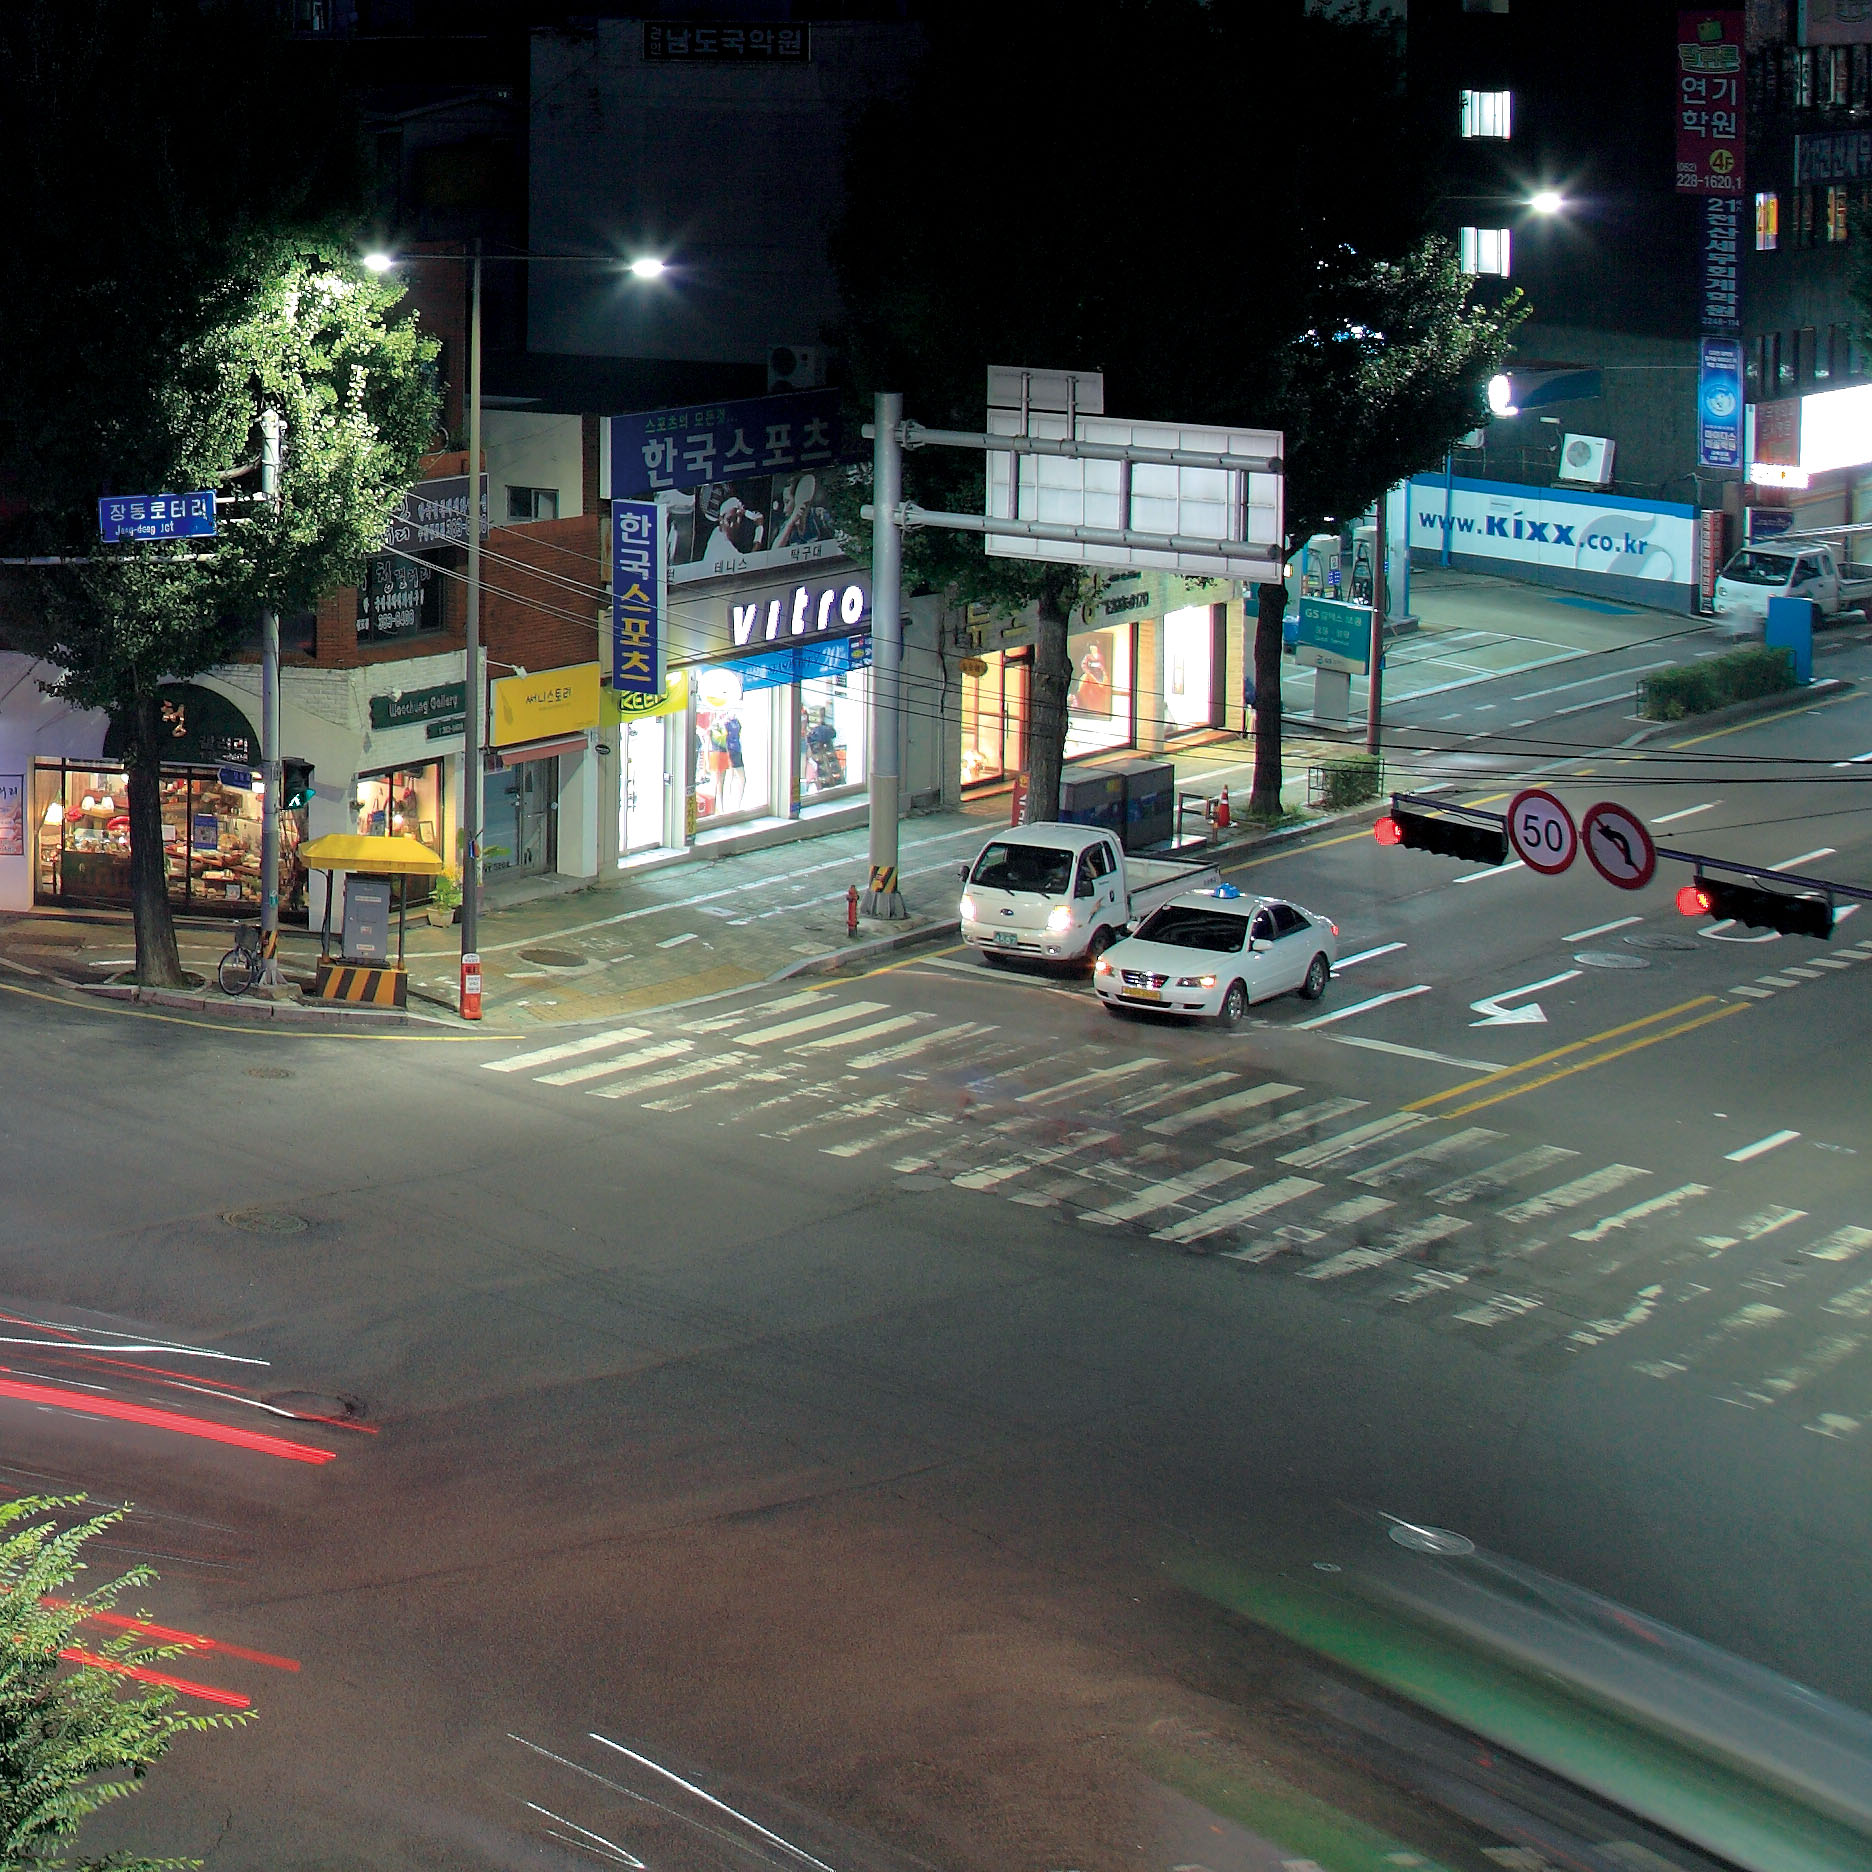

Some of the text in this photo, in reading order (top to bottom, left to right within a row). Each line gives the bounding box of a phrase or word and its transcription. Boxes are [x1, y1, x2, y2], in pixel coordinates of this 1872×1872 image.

[1681, 77, 1737, 106] 연기
[1681, 109, 1736, 139] 학원
[642, 416, 833, 489] 한국스포츠
[109, 498, 208, 521] 장동로터리
[715, 545, 823, 573] 테니스 탁구대
[1523, 813, 1562, 852] 50
